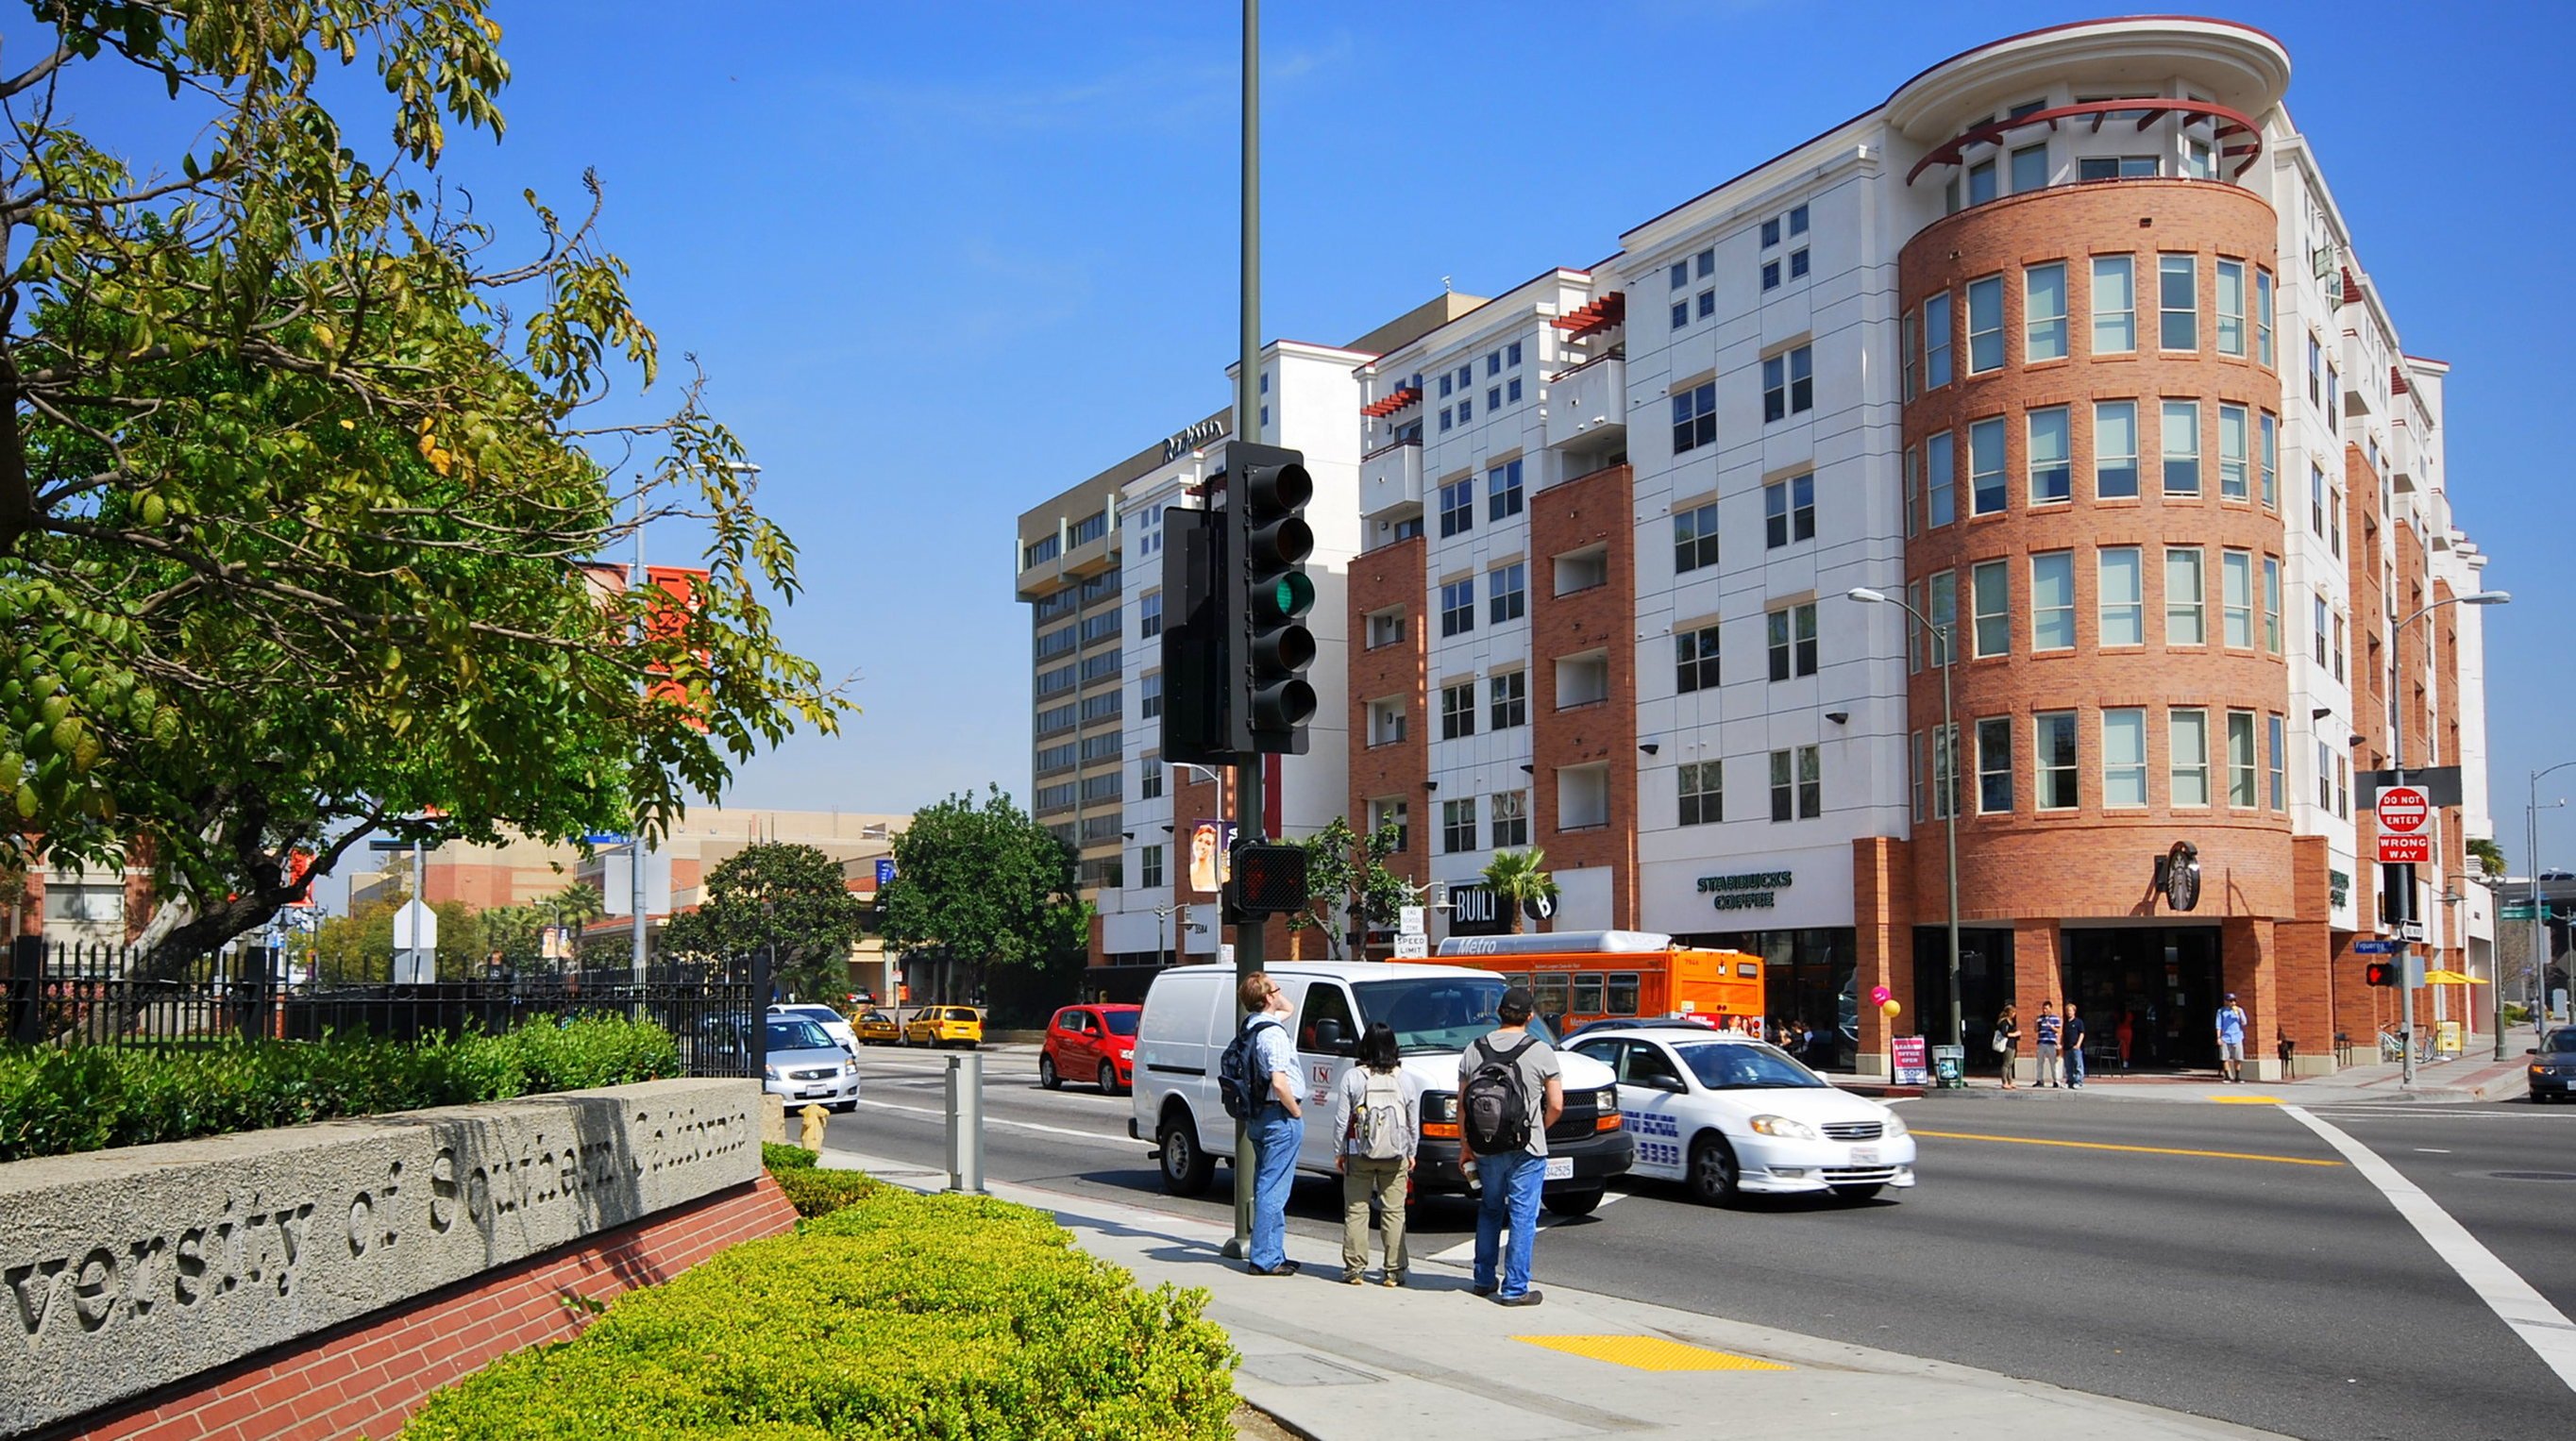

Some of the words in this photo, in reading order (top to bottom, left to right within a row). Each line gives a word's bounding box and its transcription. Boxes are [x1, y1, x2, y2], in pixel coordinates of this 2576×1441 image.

[1162, 420, 1223, 463] Radisson
[2383, 796, 2398, 805] DO
[2401, 796, 2421, 804] NOT
[2386, 815, 2419, 825] ENTER
[2380, 838, 2427, 847] WRONG
[2389, 850, 2417, 859] WAY
[1696, 870, 1793, 893] STARBUCKS
[1714, 892, 1775, 911] COFFEE
[1456, 939, 1497, 955] Metro
[1313, 1066, 1333, 1084] USC
[347, 1161, 403, 1259] of
[429, 1133, 614, 1235] Southern
[632, 1102, 747, 1181] California
